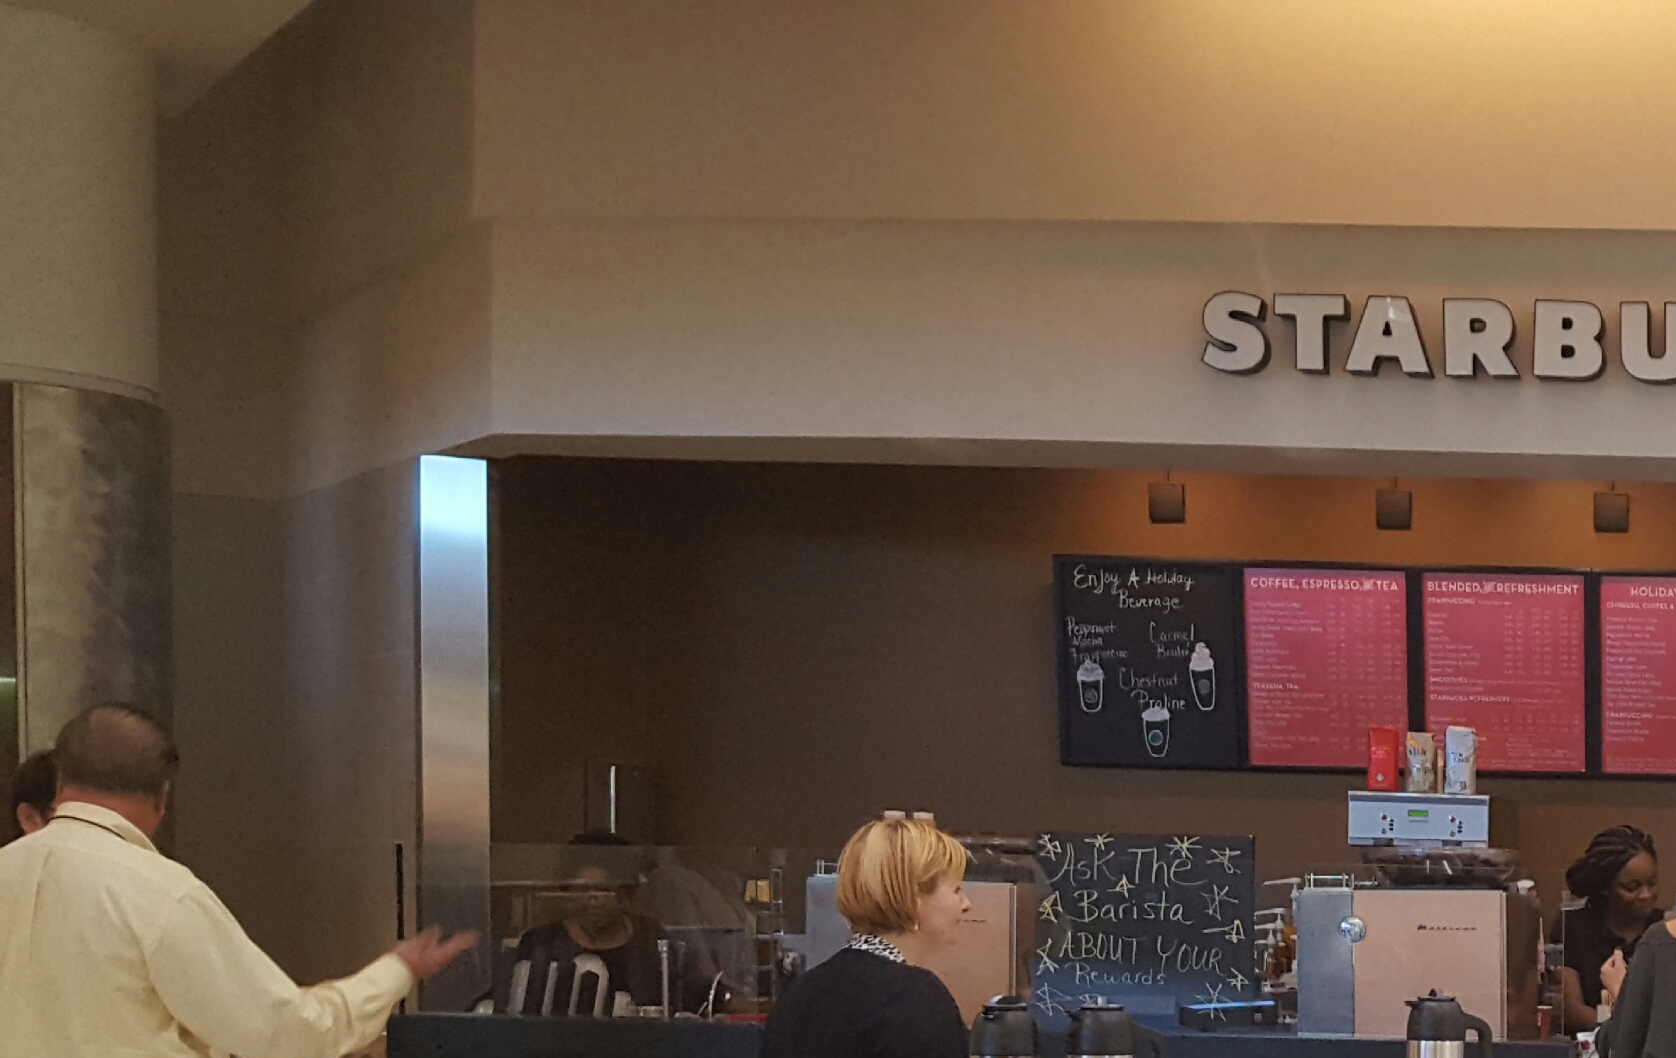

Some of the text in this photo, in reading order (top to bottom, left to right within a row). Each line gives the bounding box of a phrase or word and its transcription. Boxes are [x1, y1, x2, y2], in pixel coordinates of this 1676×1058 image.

[1073, 564, 1195, 595] Enjoy A Holiday
[1250, 577, 1299, 590] COFFEE,
[1376, 580, 1399, 591] TEA
[1427, 581, 1480, 593] BLENDED
[1496, 582, 1579, 595] REFRESHMENT
[1118, 589, 1184, 613] Beverage
[1119, 666, 1178, 691] Chestnut
[1130, 689, 1186, 711] Praline
[1127, 846, 1208, 887] The
[1066, 889, 1194, 925] Barista
[1059, 929, 1227, 977] ABOUT YOUR
[1064, 961, 1167, 987] Rewards
